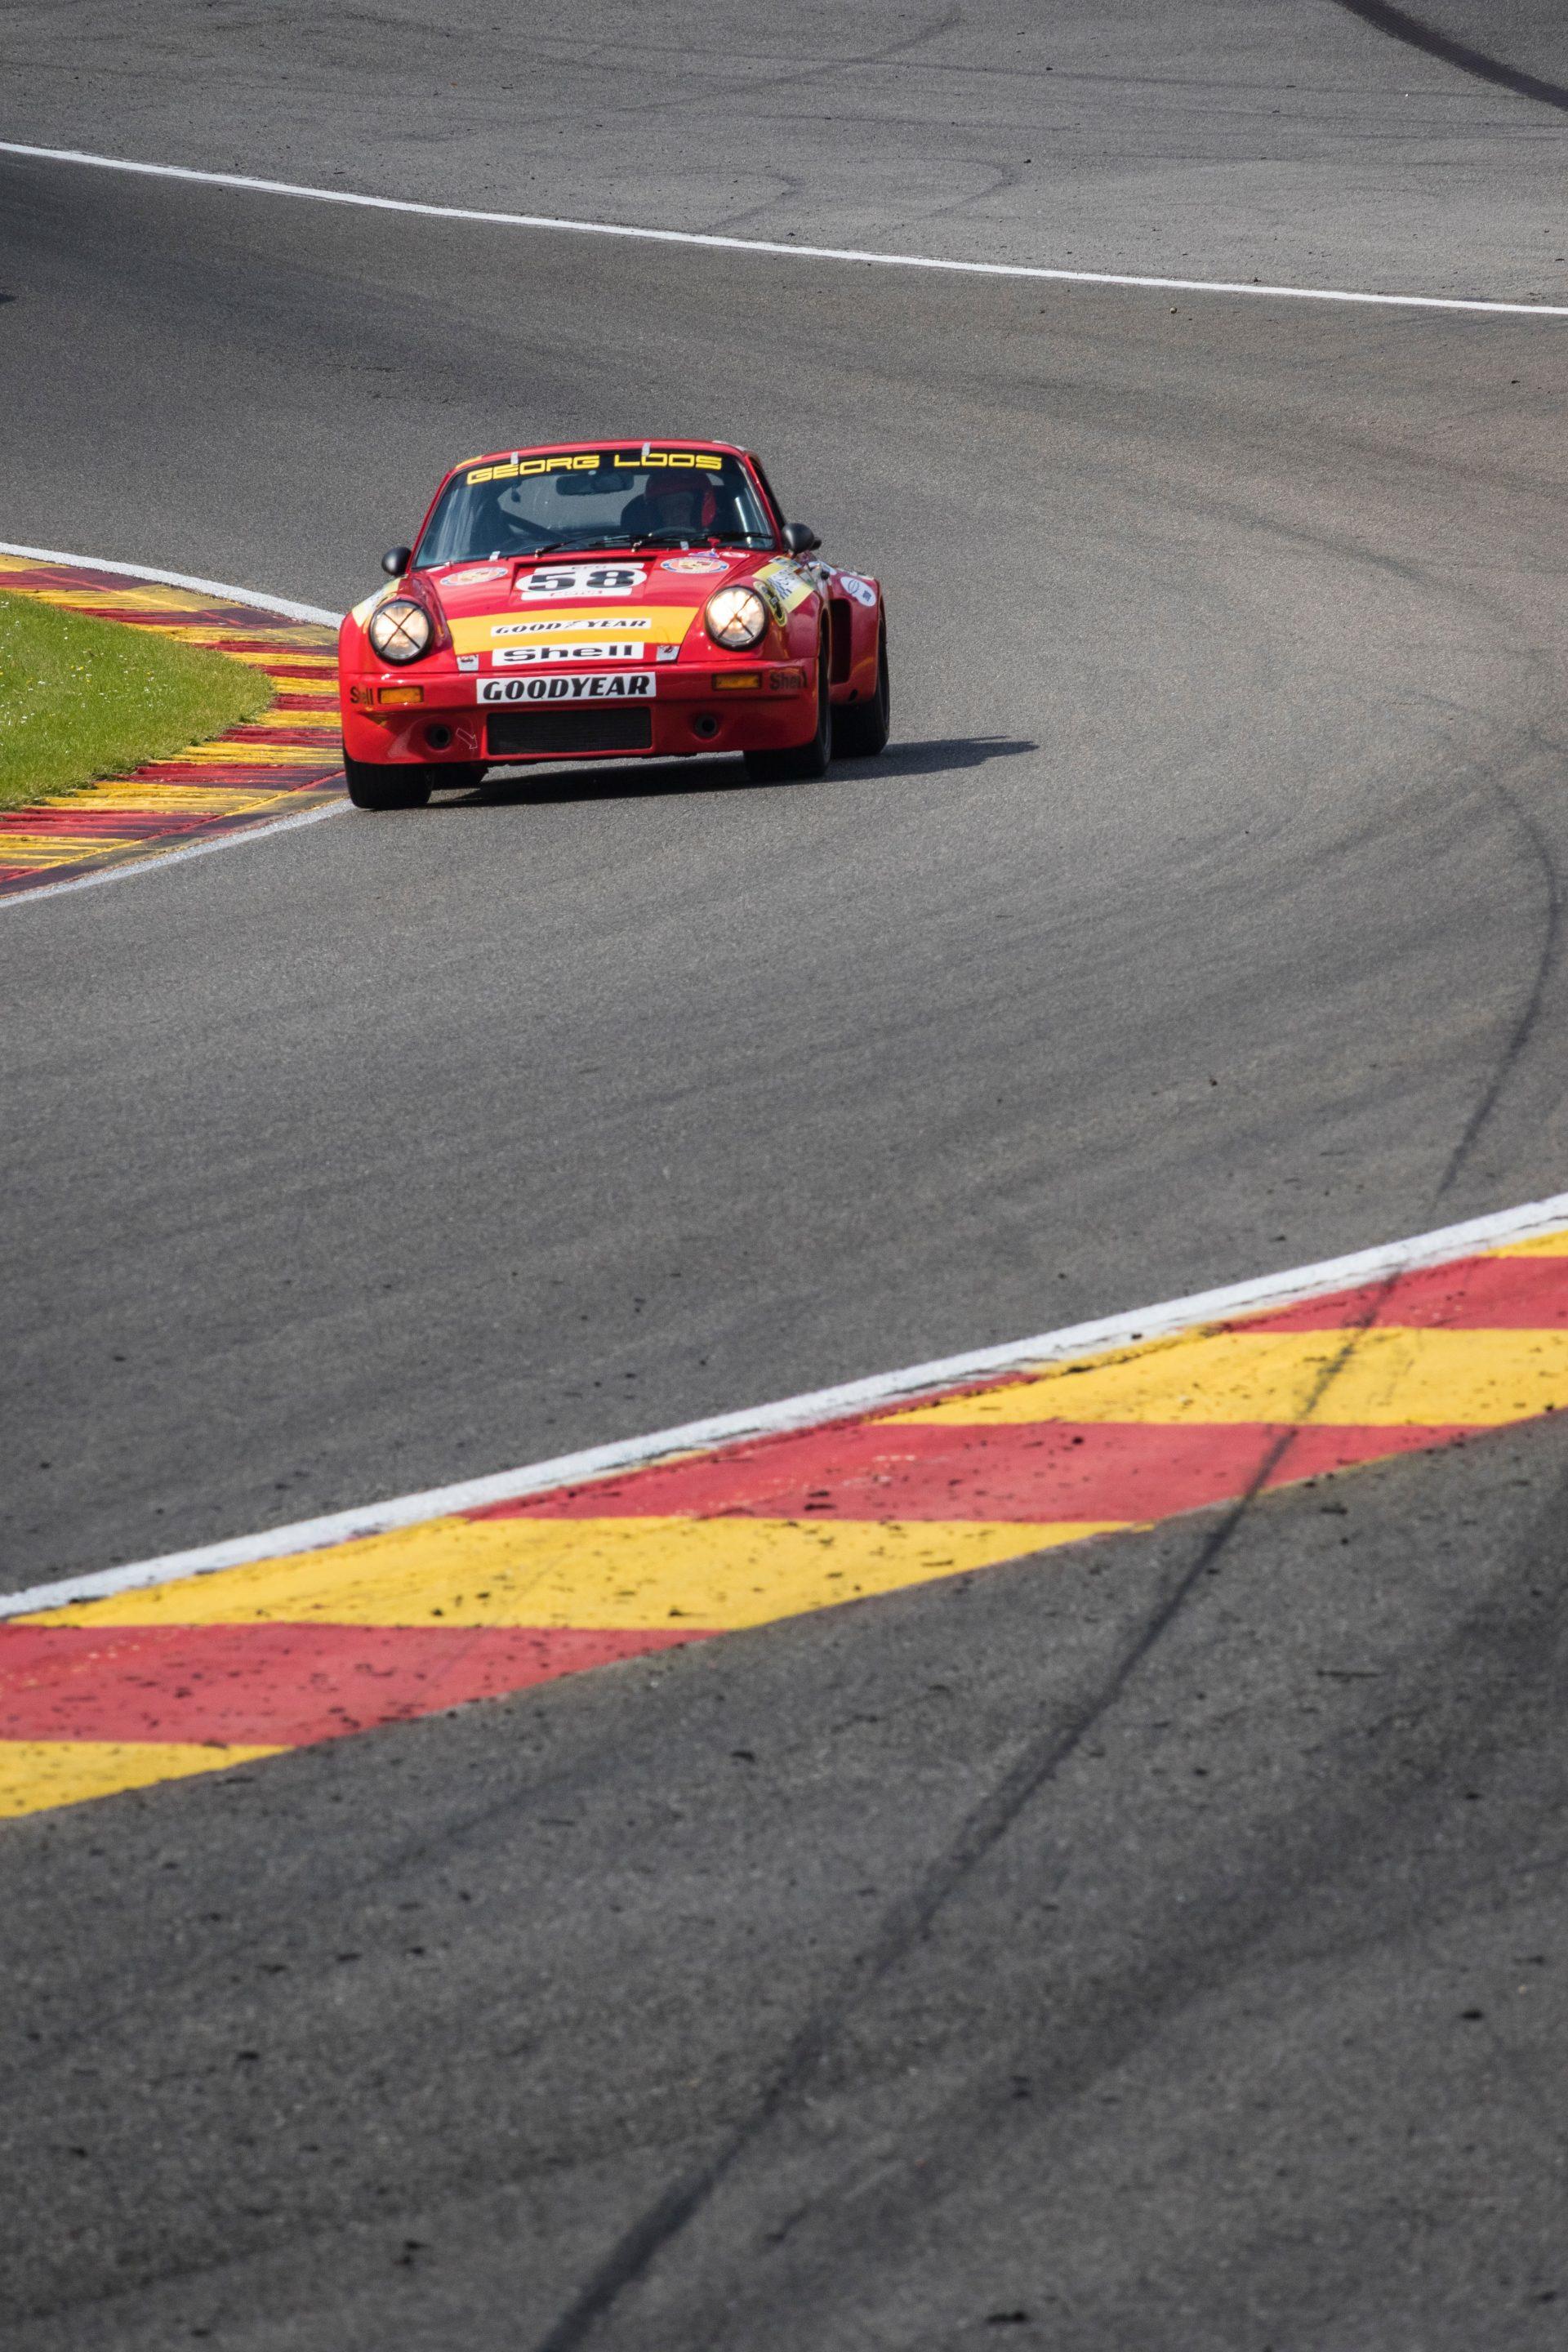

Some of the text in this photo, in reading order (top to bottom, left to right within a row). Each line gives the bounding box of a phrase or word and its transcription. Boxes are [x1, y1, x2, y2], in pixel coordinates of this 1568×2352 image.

[466, 453, 722, 484] GEORG LOOS
[528, 570, 635, 591] 58
[503, 645, 632, 662] Shell
[483, 675, 650, 701] GOODYEAR
